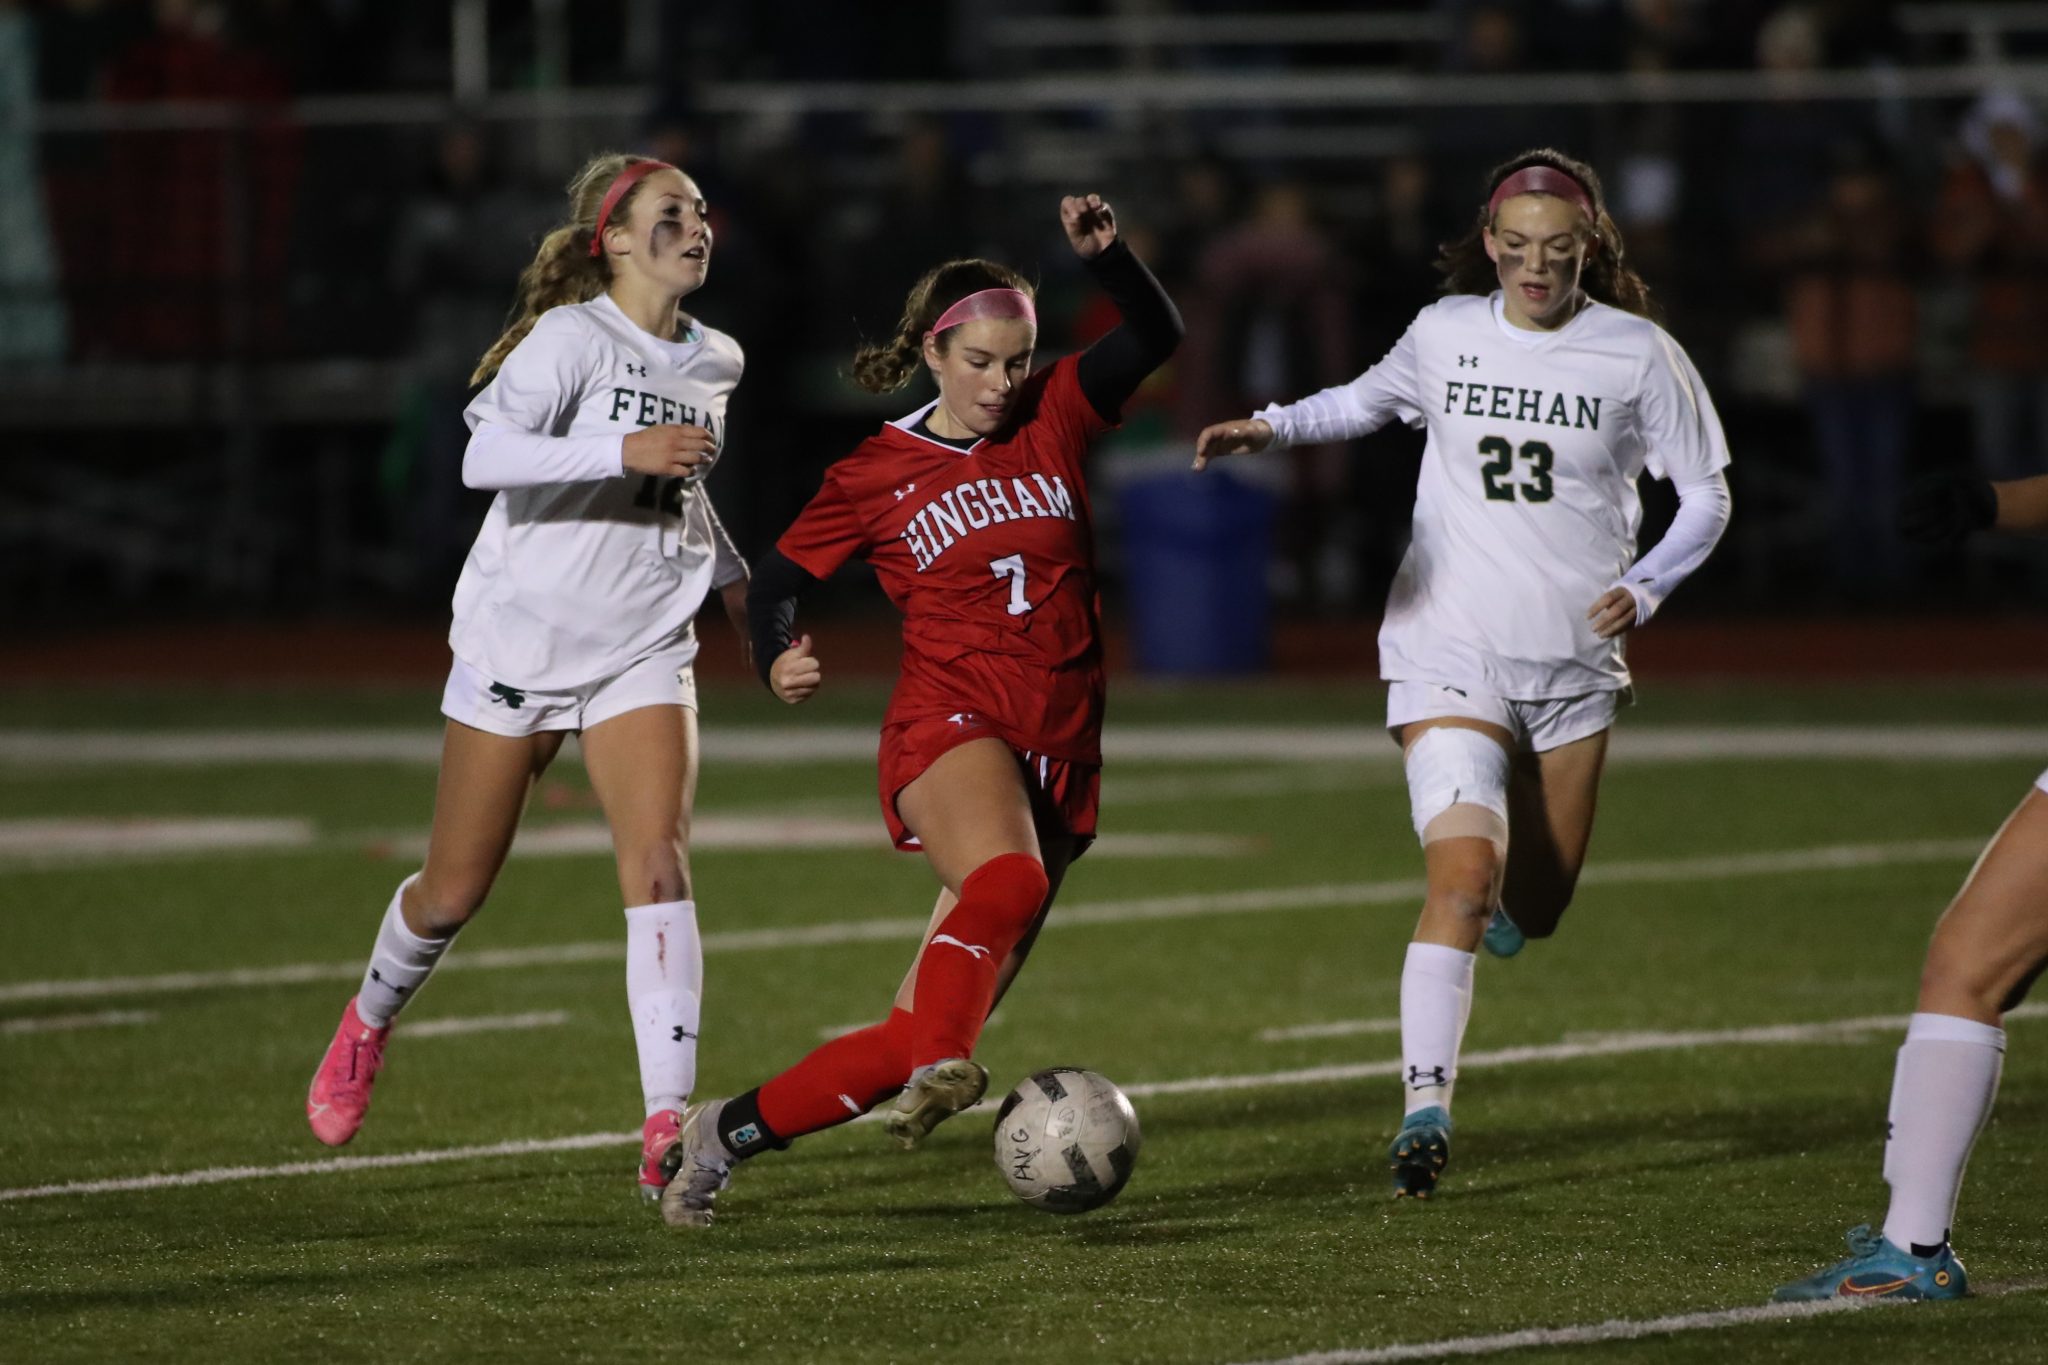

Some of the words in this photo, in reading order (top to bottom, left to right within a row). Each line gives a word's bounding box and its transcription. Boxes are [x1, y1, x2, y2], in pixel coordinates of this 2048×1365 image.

[1445, 381, 1602, 431] FEEHAN
[1478, 434, 1555, 503] 23
[900, 473, 1075, 573] HINGHAM
[989, 553, 1032, 615] 7
